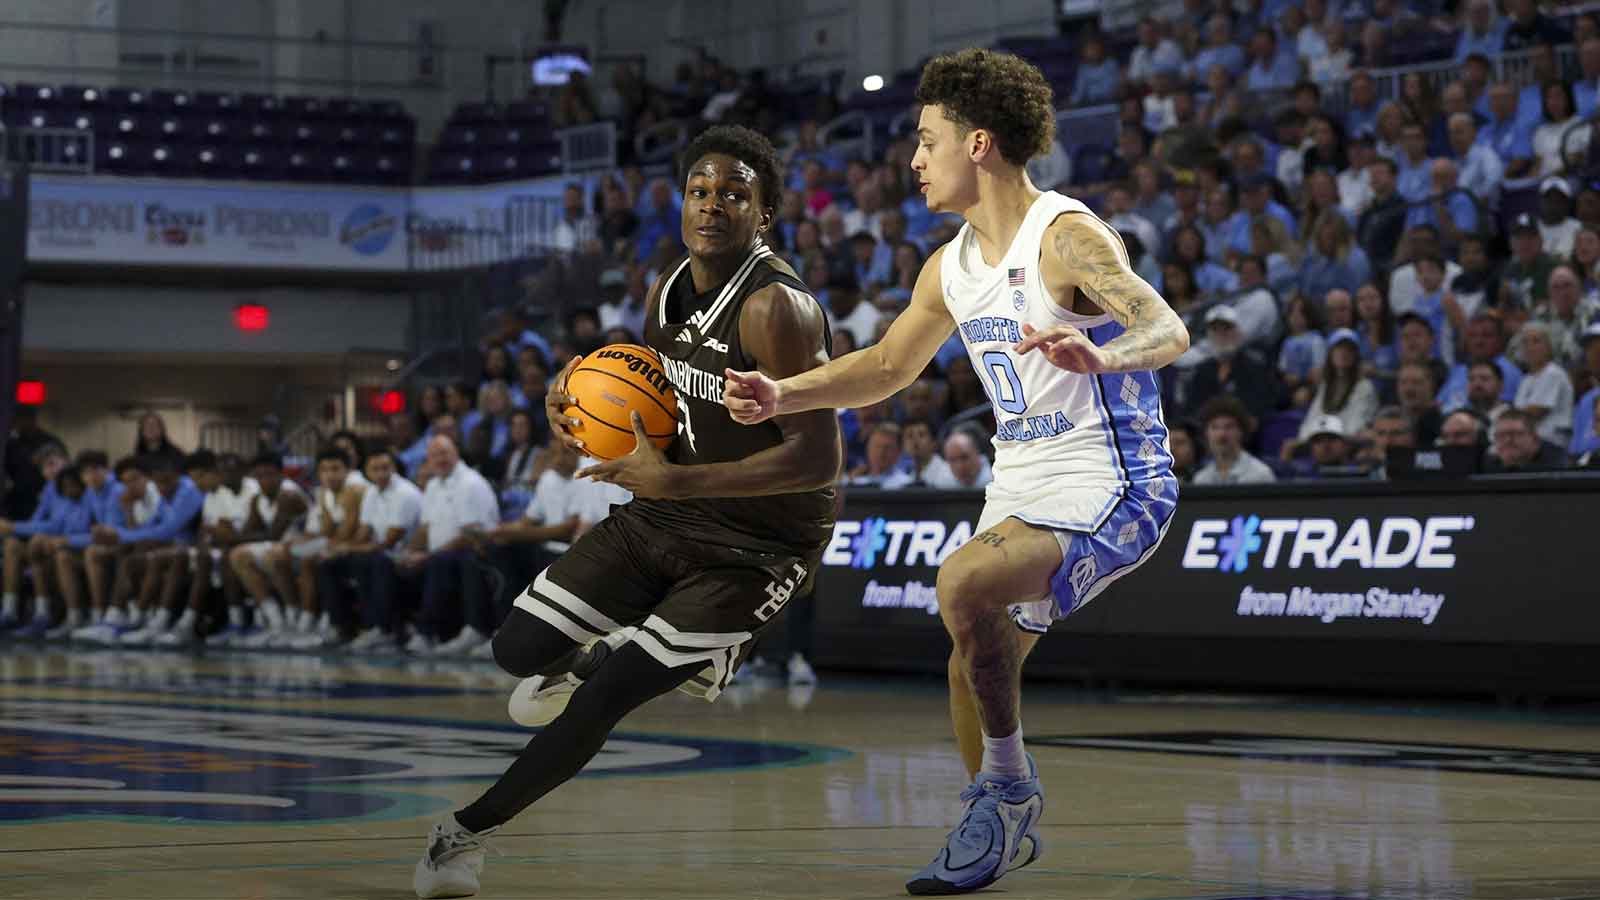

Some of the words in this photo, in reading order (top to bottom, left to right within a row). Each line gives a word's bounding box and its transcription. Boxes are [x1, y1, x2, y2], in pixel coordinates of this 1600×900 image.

[28, 199, 135, 233] ERONI
[960, 317, 1024, 343] NORTH
[982, 351, 1027, 414] 0
[822, 517, 973, 569] ETRA
[863, 580, 902, 607] from
[903, 581, 939, 615] Morg
[1237, 585, 1287, 615] from
[1286, 586, 1364, 623] Morgan
[1363, 586, 1445, 624] Stanley
